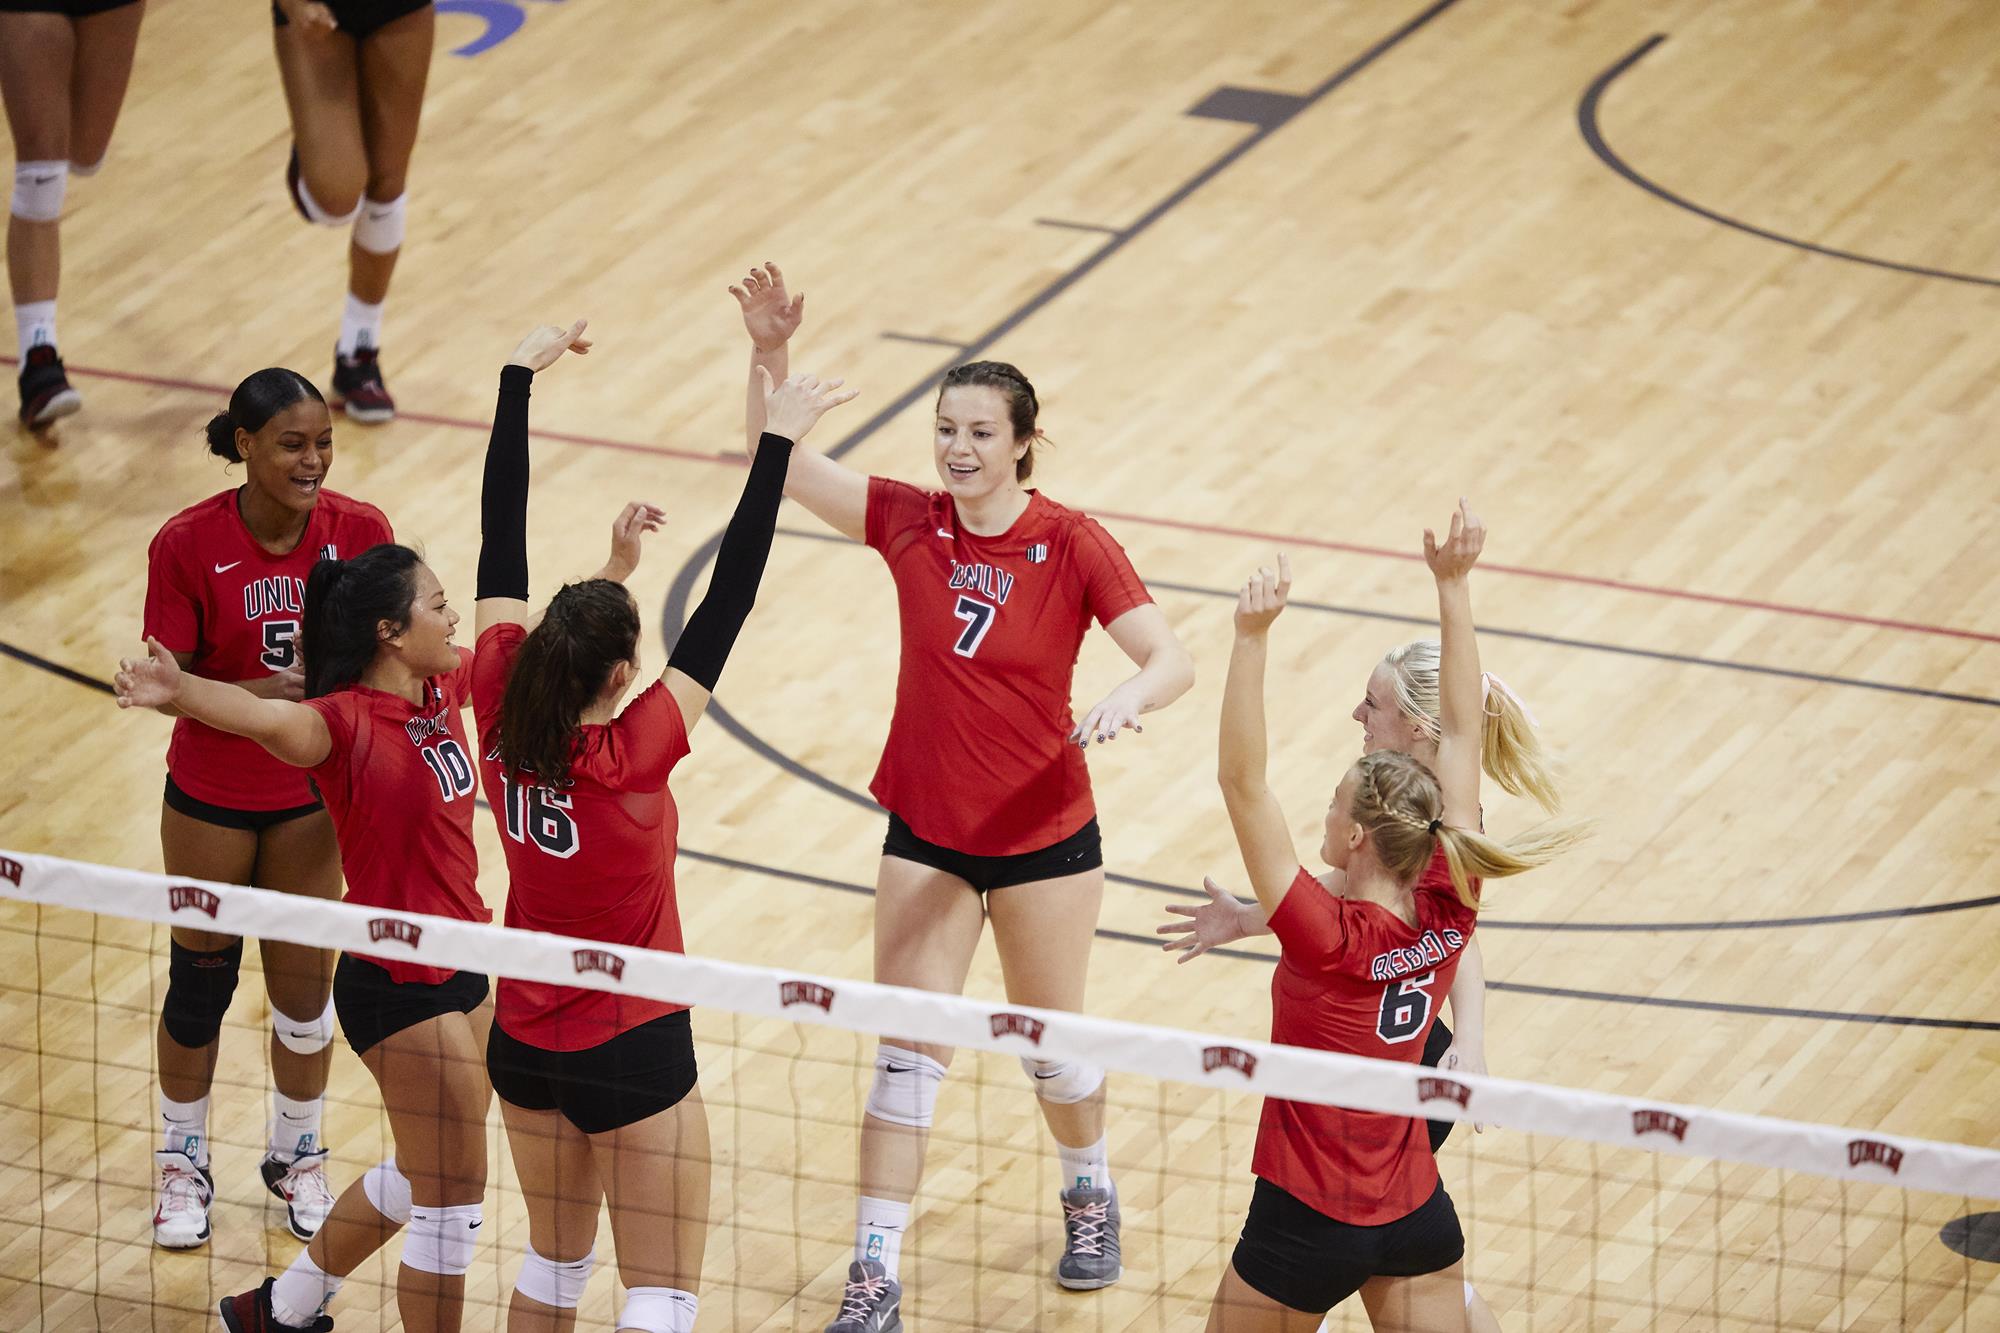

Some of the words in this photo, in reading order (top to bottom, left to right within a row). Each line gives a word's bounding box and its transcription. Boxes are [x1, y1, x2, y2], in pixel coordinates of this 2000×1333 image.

[949, 559, 1014, 605] UNLV
[260, 620, 300, 672] 5
[954, 595, 996, 659] 7
[421, 739, 475, 803] 10
[500, 772, 580, 859] 16
[168, 886, 221, 920] UNLV
[368, 918, 423, 950] UNLV
[1372, 929, 1464, 982] REBELS
[571, 948, 626, 982] UNLV
[780, 981, 835, 1013] UNLV
[1376, 971, 1435, 1045] 6
